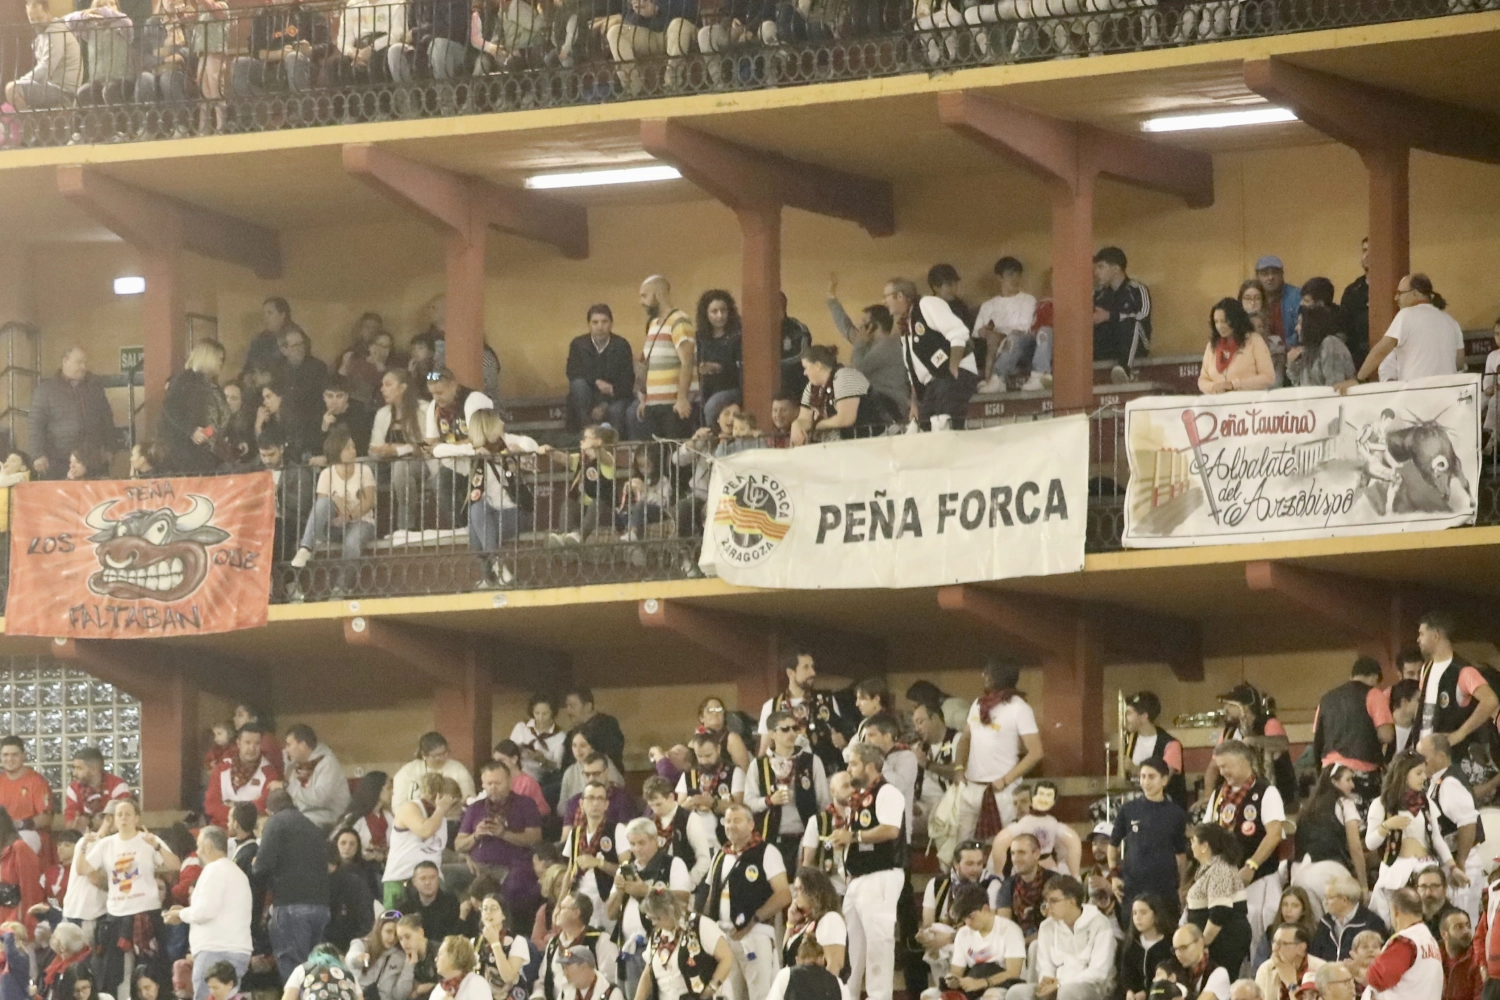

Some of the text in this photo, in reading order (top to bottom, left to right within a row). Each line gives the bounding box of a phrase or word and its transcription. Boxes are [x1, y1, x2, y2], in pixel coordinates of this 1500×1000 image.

[1190, 443, 1298, 481] Albalate
[761, 474, 790, 519] FORCA
[1218, 480, 1242, 502] del
[1219, 478, 1355, 528] Arzobispo
[815, 478, 1069, 545] PEÑA FORCA
[27, 532, 260, 571] LOS QUE
[68, 605, 202, 632] FALTABAN
